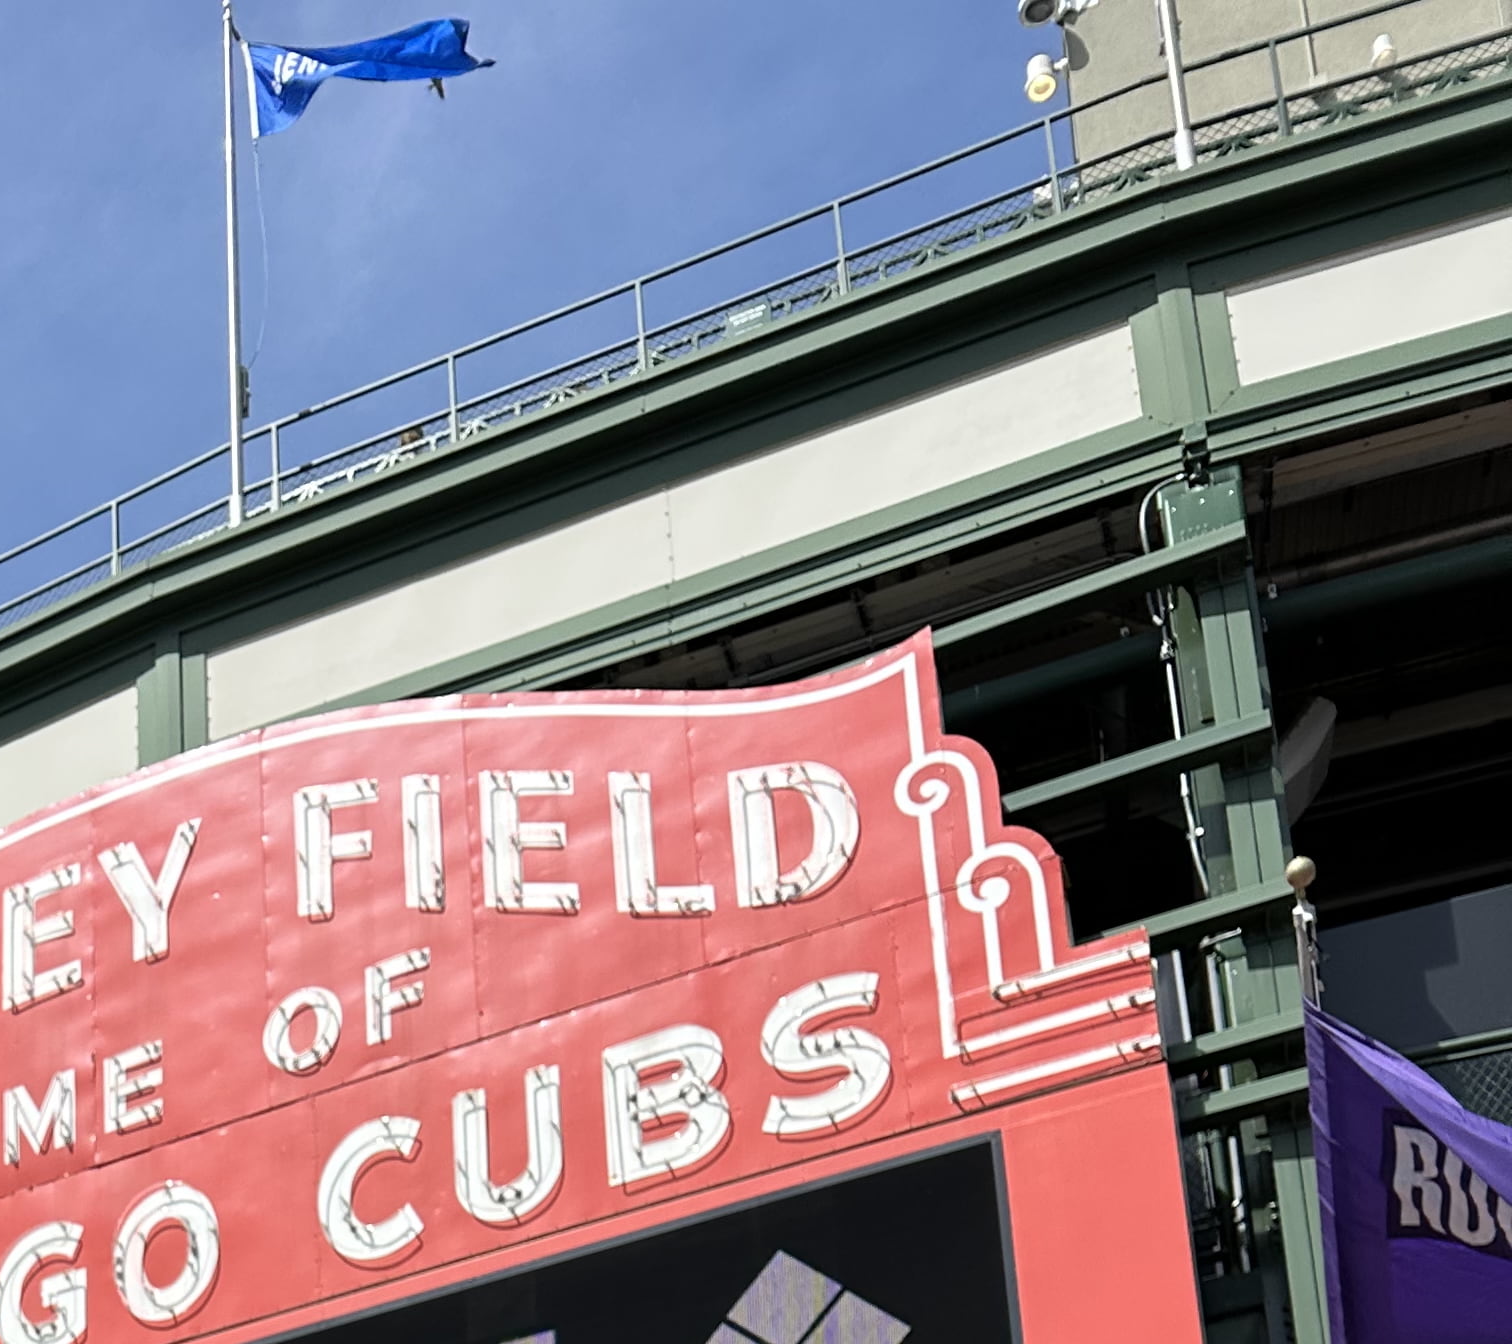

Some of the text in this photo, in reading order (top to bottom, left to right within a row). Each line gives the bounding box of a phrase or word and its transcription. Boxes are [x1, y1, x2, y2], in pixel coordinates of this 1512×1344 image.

[294, 761, 859, 922] FIELD
[262, 948, 431, 1076] OF
[317, 973, 891, 1267] CUBS
